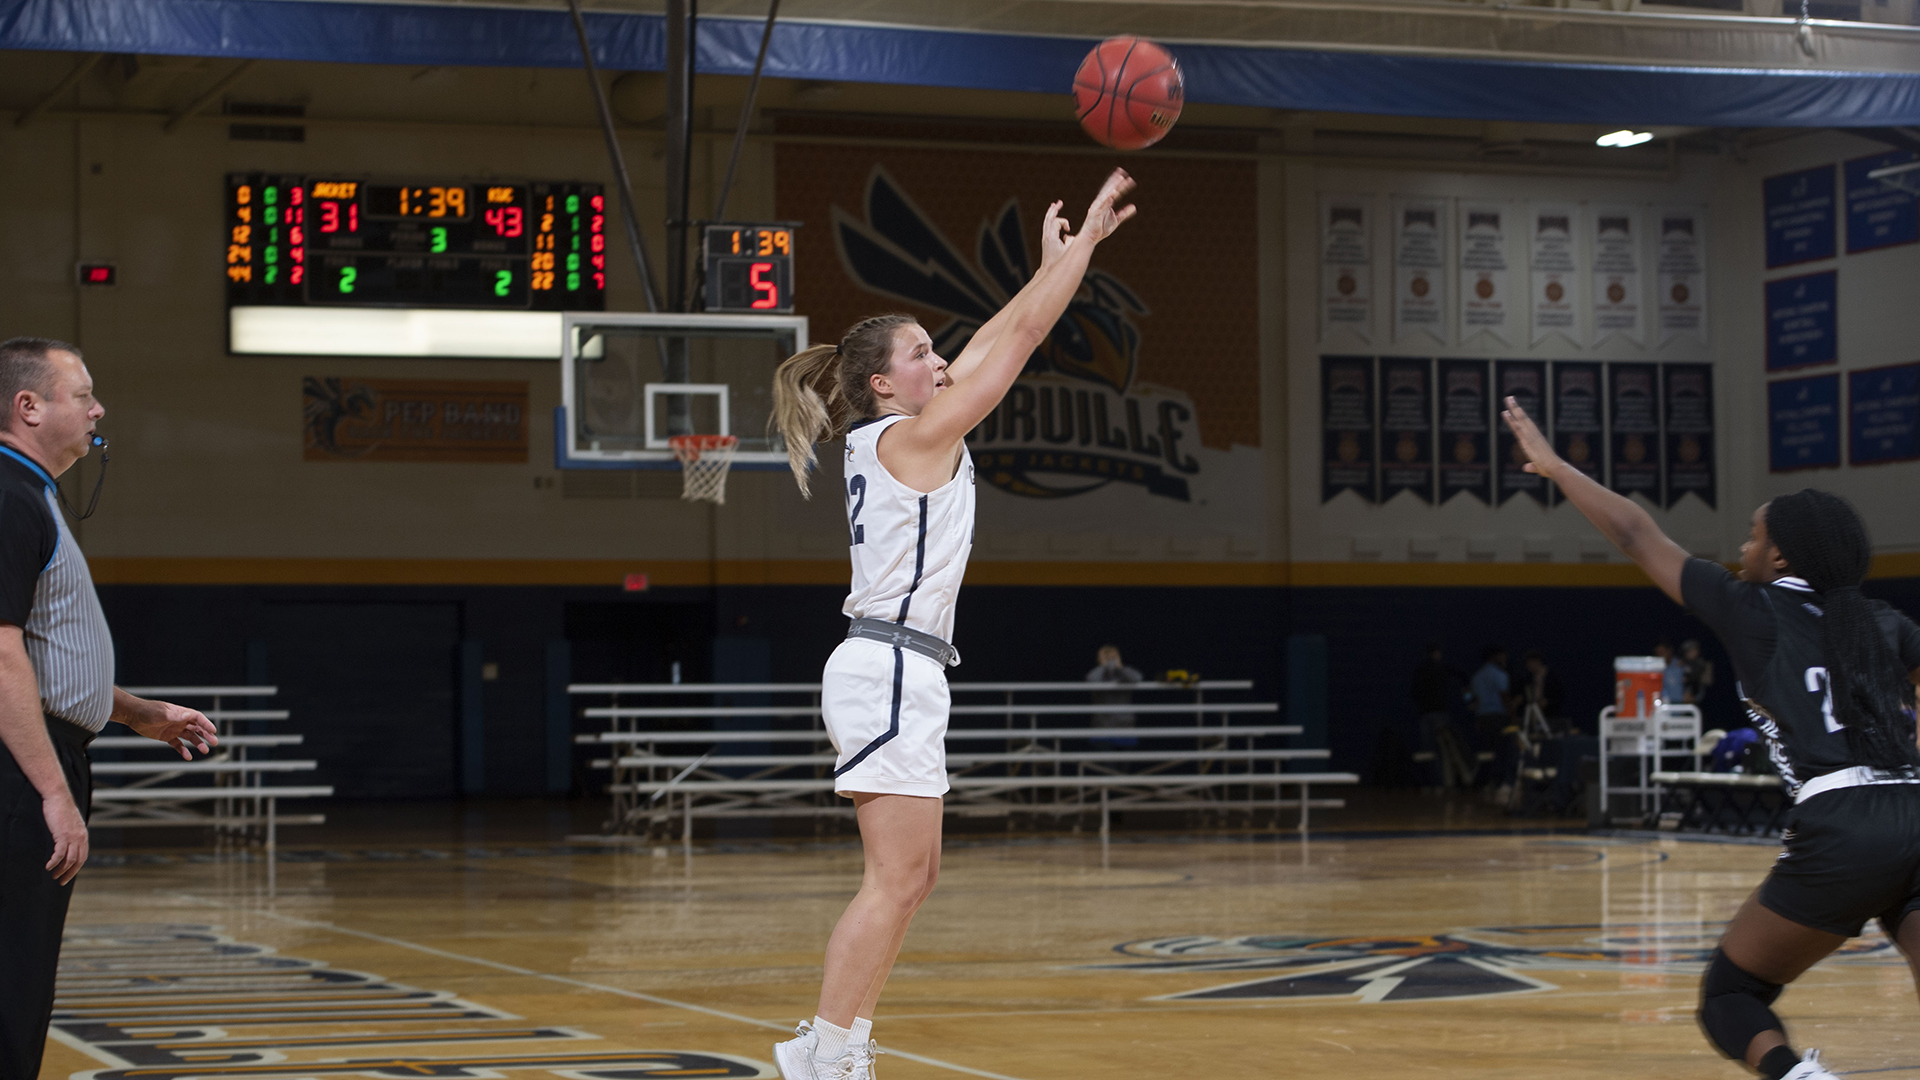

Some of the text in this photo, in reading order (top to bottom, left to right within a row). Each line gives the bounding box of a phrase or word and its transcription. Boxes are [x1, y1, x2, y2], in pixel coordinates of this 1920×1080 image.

[291, 187, 303, 205] 3
[401, 187, 464, 217] 1:39
[546, 195, 554, 211] 1
[285, 207, 303, 224] 11
[321, 202, 357, 232] 31
[486, 207, 522, 237] 43
[540, 213, 604, 233] 2 1 2
[269, 226, 278, 244] 1
[290, 226, 303, 245] 6
[432, 228, 446, 252] 3
[536, 233, 604, 252] 11 1 0
[732, 230, 790, 256] 1:39
[228, 243, 251, 263] 24
[290, 247, 304, 263] 4
[592, 254, 604, 270] 4
[265, 265, 277, 284] 2
[290, 265, 304, 284] 2
[340, 267, 356, 292] 2
[495, 271, 511, 296] 2
[530, 270, 555, 291] 22
[749, 263, 778, 309] 5
[383, 401, 521, 426] PEP BAND
[1028, 452, 1145, 480] JACKETS
